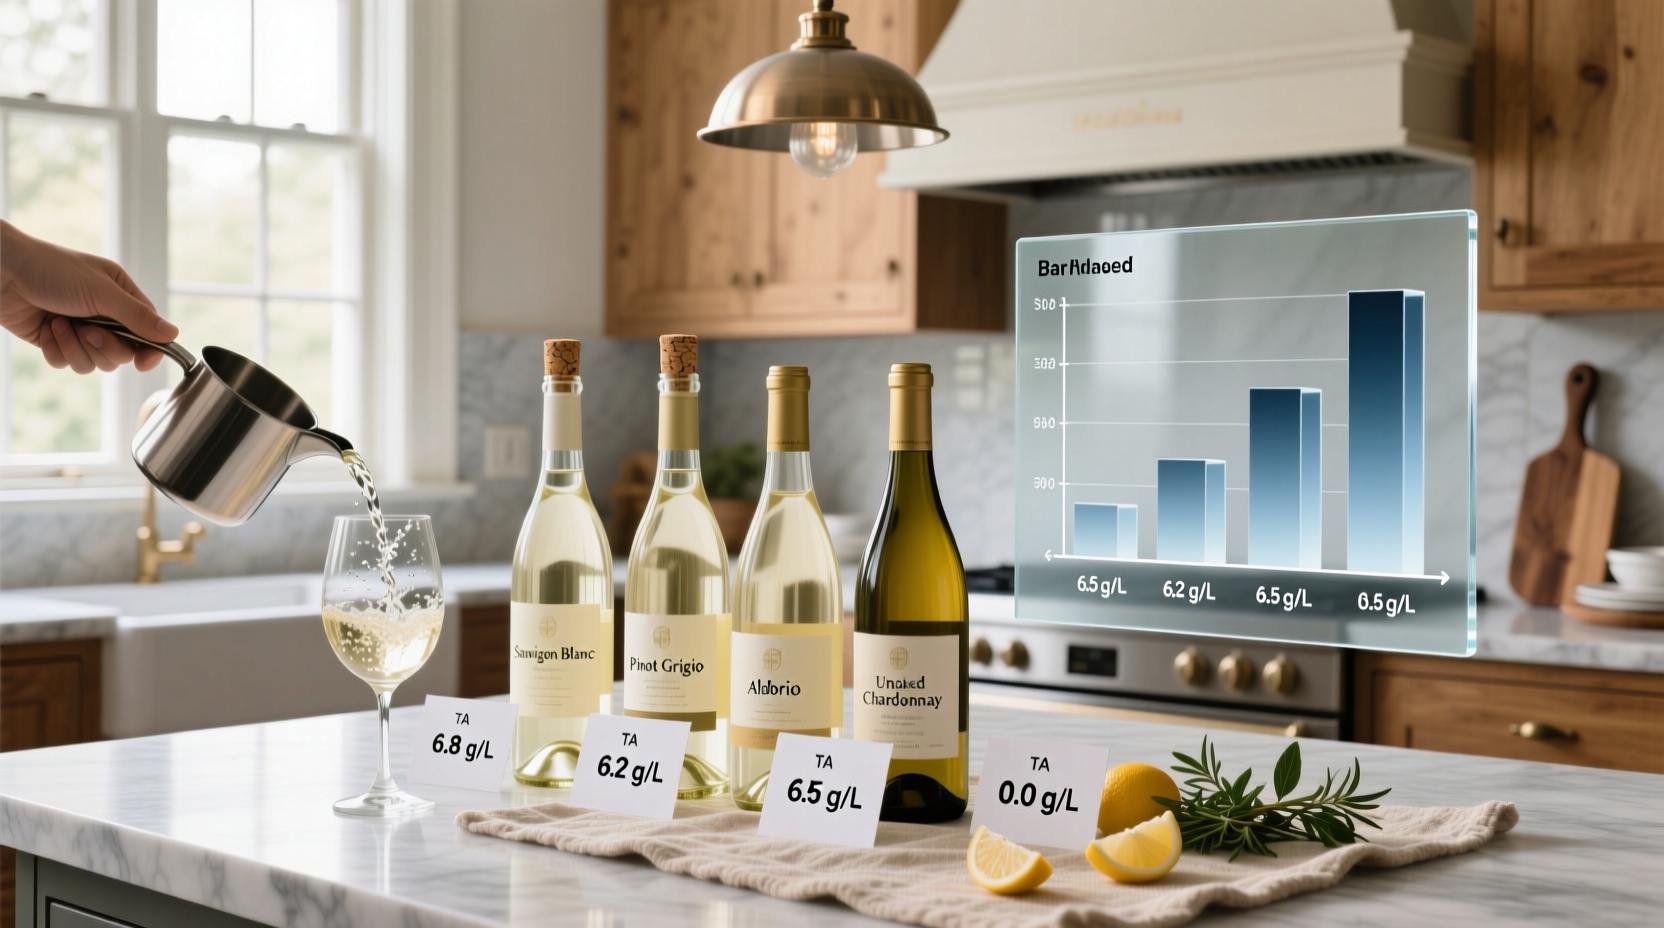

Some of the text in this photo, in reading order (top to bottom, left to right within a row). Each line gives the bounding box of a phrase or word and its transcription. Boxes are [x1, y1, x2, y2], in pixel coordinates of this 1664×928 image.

[1038, 260, 1067, 277] Bar
[1077, 575, 1127, 599] 6.5 g/L
[1162, 580, 1216, 604] 6.2 g/L
[1256, 586, 1313, 611] 6.5 g/L
[1386, 594, 1416, 618] g/L
[561, 646, 596, 660] Blanc
[630, 656, 704, 677] Pinot Grigio
[863, 691, 943, 710] Chardonnay
[455, 712, 470, 726] TA
[432, 733, 494, 762] 6.8 g/L
[622, 733, 638, 747] TA
[597, 755, 664, 787] 6.2 g/L
[815, 754, 833, 770] TA
[1030, 756, 1050, 772] TA
[787, 778, 862, 813] 6.5 g/L
[999, 780, 1079, 815] 0.0 g/L
